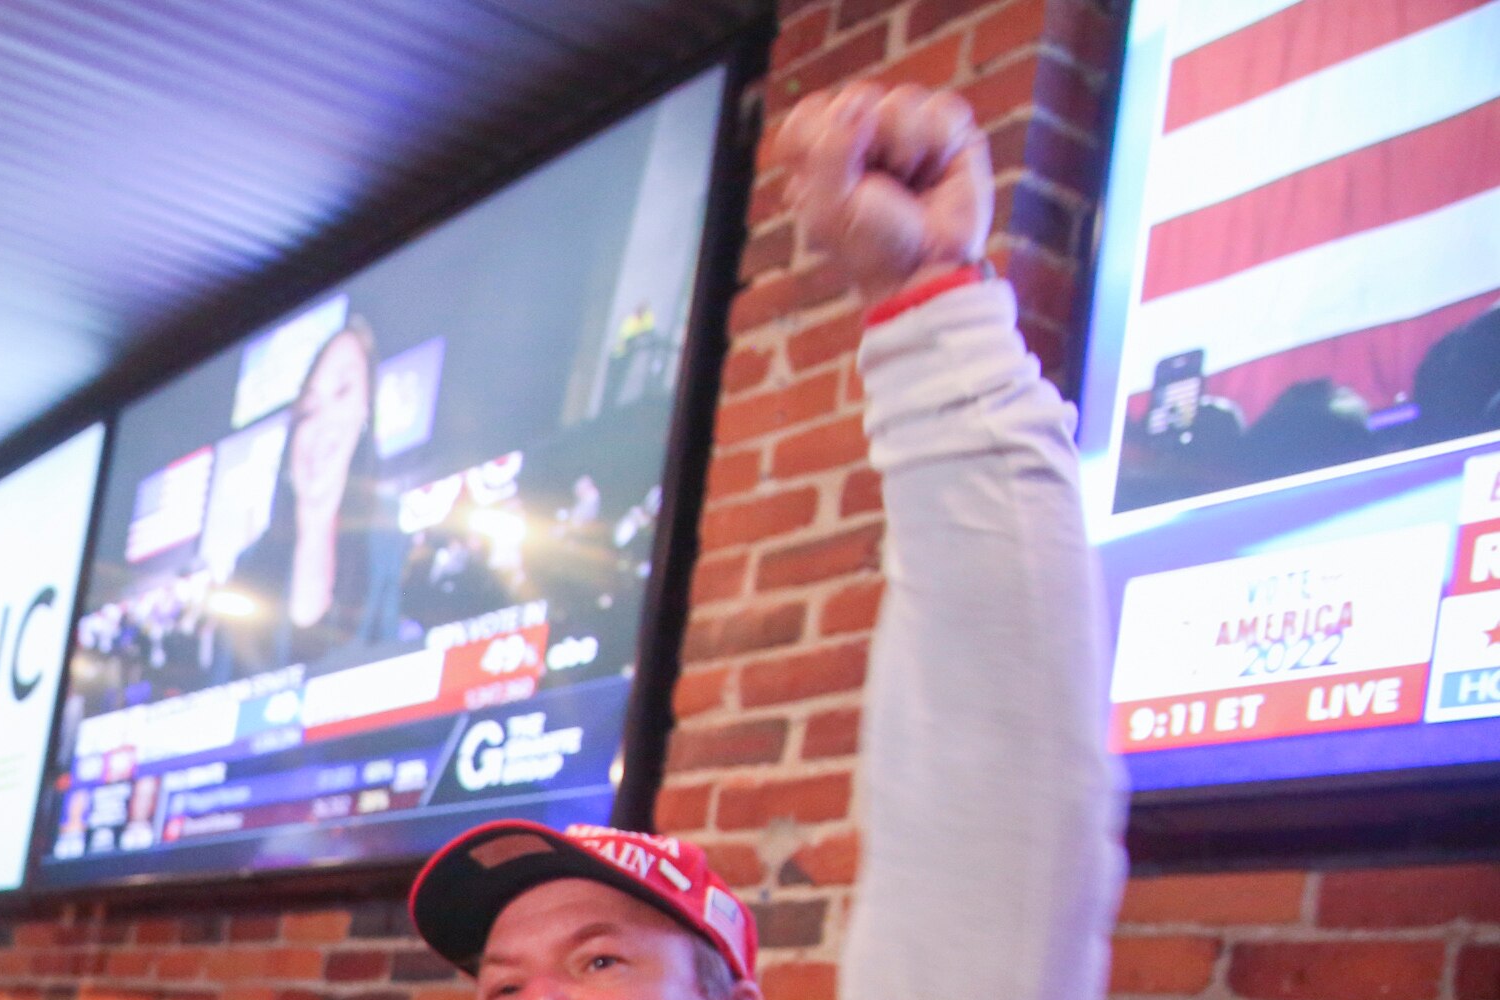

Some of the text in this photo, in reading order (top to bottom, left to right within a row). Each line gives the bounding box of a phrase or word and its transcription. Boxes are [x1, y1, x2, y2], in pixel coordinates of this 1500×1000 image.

[1214, 600, 1354, 646] AMERICA
[1238, 631, 1345, 677] 2022
[1128, 676, 1402, 742] 9:11 ET LIVE
